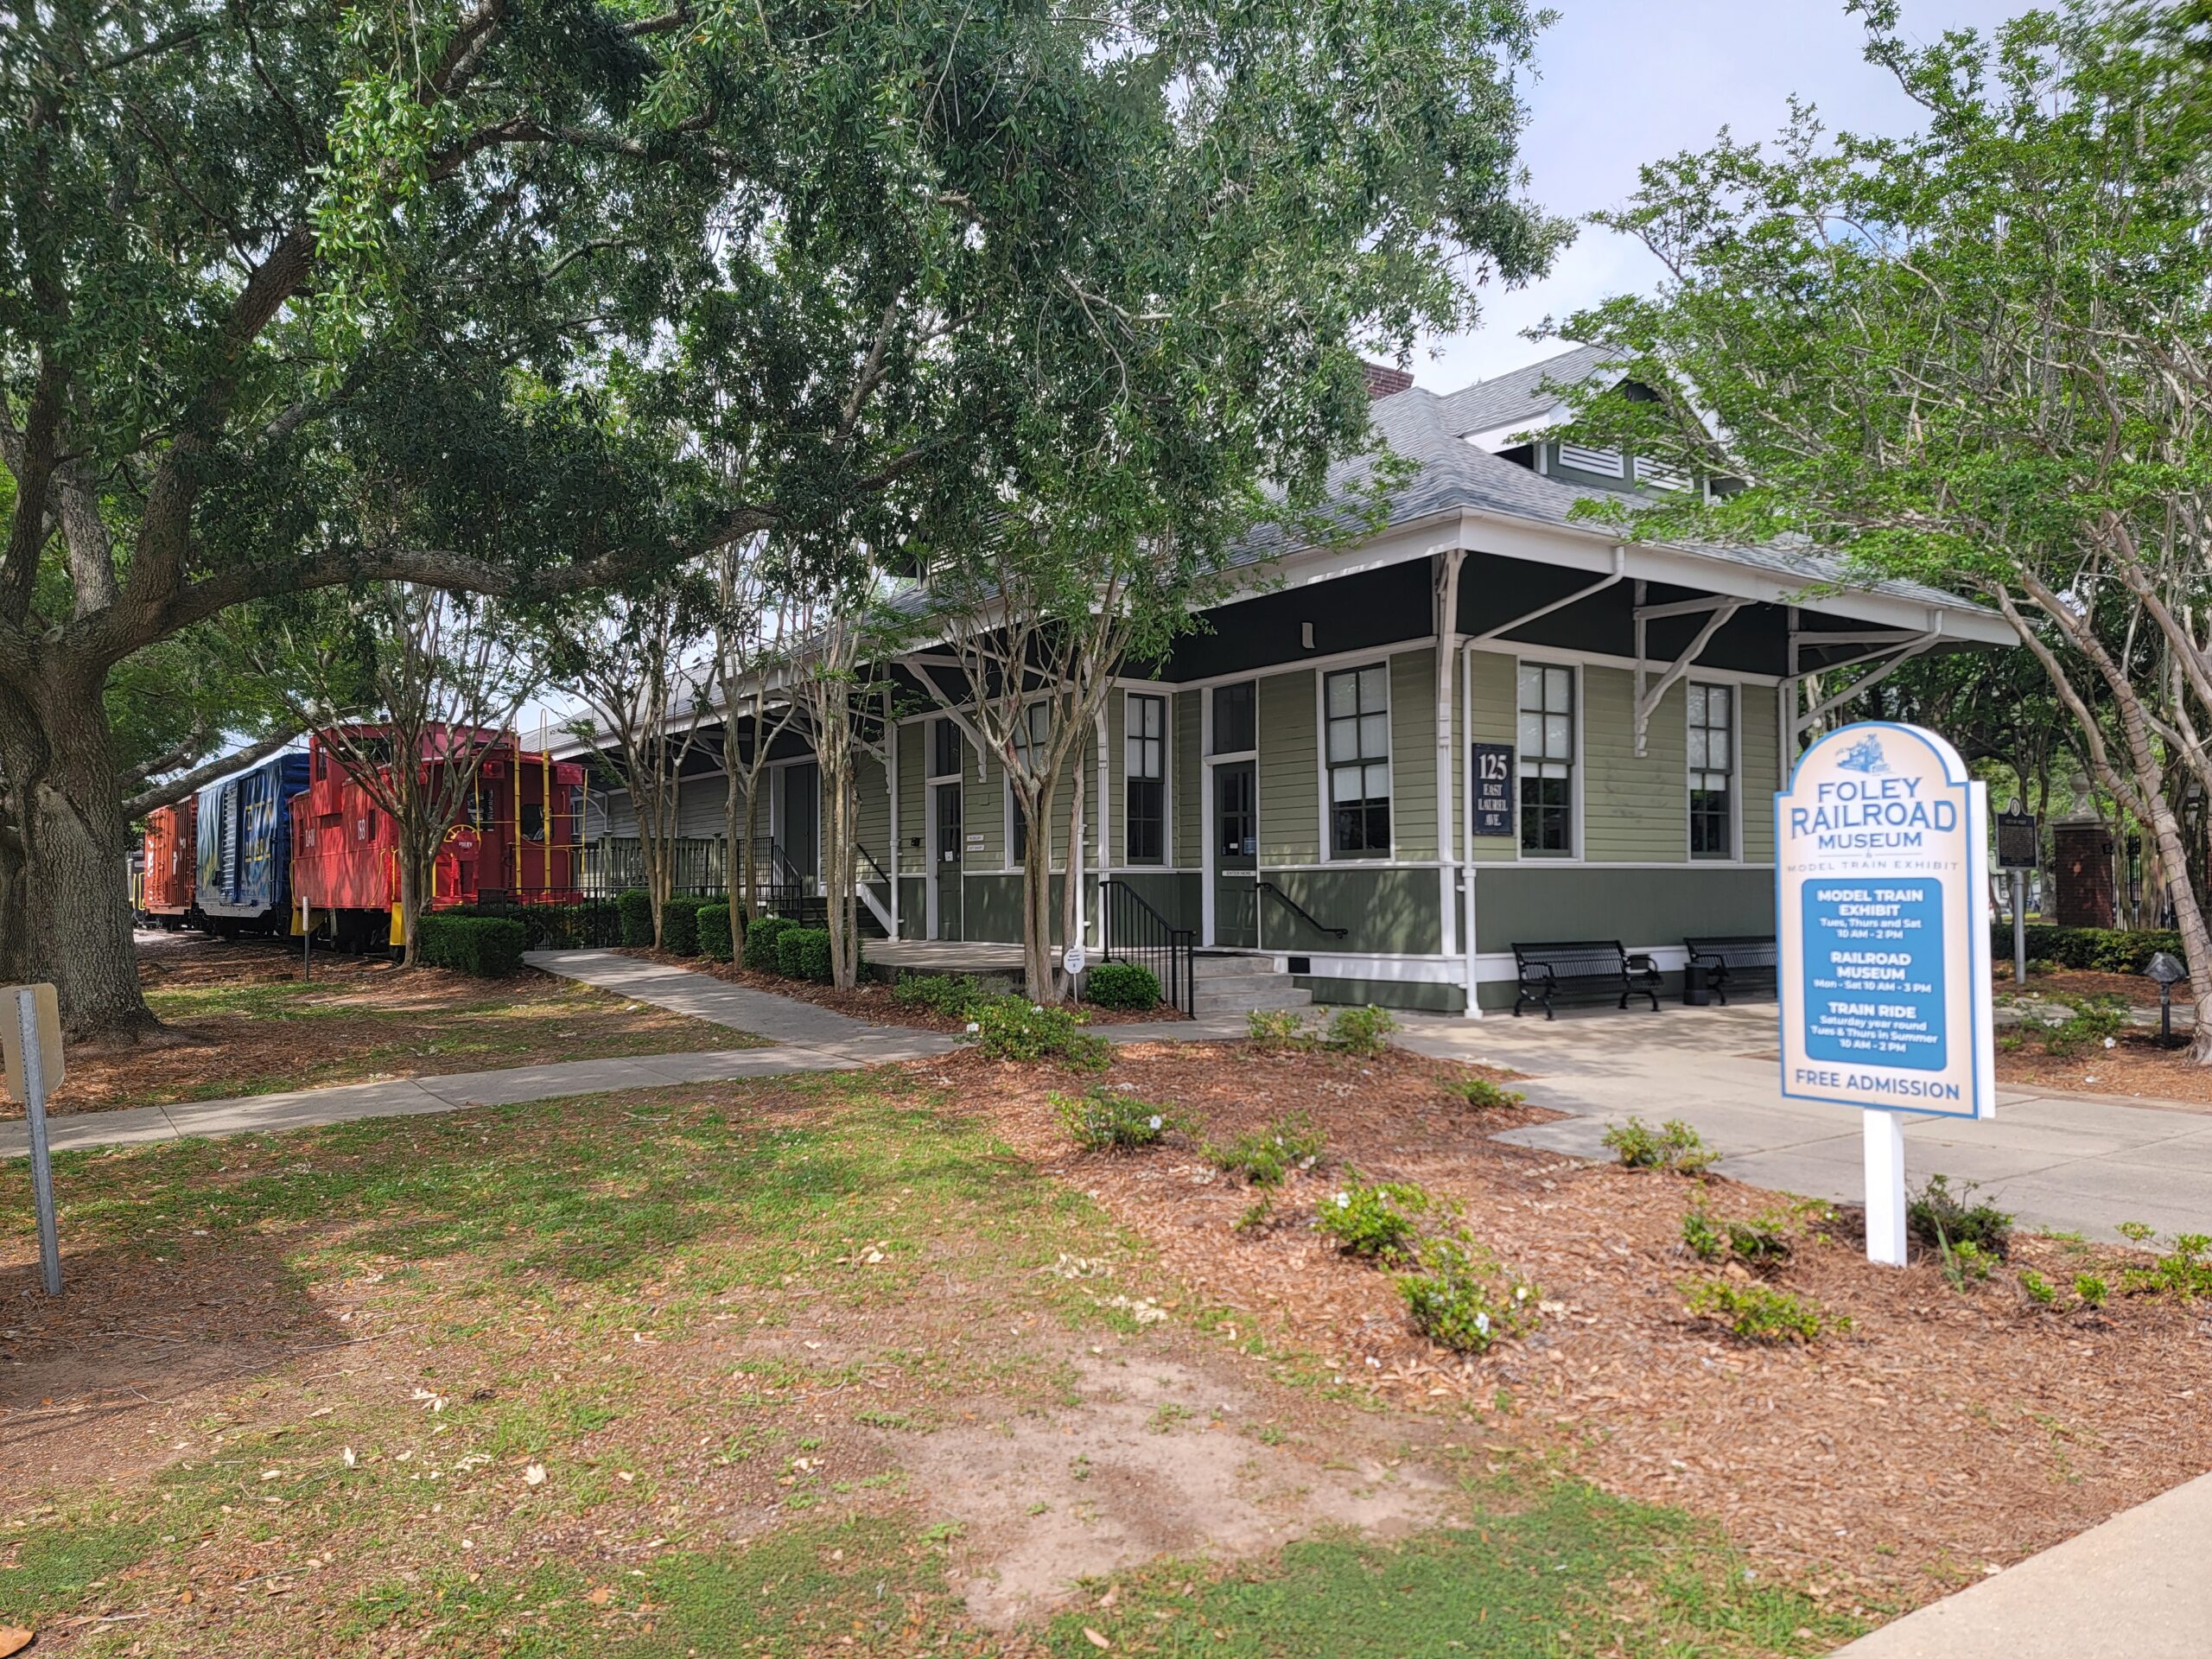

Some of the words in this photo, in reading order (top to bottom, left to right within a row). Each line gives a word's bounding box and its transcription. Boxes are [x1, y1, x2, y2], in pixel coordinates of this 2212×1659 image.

[1478, 753, 1507, 780] 125
[1483, 783, 1503, 796] EAST
[1817, 777, 1923, 803] FOLEY
[1790, 800, 1957, 839] RAILROAD
[1818, 831, 1923, 850] MUSEUM
[1787, 862, 1835, 873] MODEL
[1842, 861, 1887, 869] TRAIN
[1894, 861, 1959, 871] EXHIBIT
[1817, 889, 1872, 902] MODEL
[1874, 889, 1923, 902] TRAIN
[1839, 904, 1901, 916] EXHIBIT
[1820, 918, 1847, 928] Tues,
[1849, 918, 1878, 927] Thurs
[1879, 918, 1901, 928] and
[1903, 918, 1923, 929] Sat
[1837, 930, 1848, 938] 10
[1851, 930, 1868, 938] AM
[1876, 930, 1884, 939] 2
[1885, 930, 1904, 939] PM
[1830, 950, 1912, 966] RAILROAD
[1836, 966, 1905, 981] MUSEUM
[1814, 978, 1837, 989] Mon
[1844, 980, 1862, 990] Sat
[1863, 981, 1875, 990] 10
[1877, 982, 1896, 992] AM
[1904, 982, 1911, 993] 3
[1912, 983, 1932, 994] PM
[1827, 1001, 1875, 1016] TRAIN
[1878, 1004, 1916, 1020] RIDE
[1819, 1014, 1867, 1028] Saturday
[1867, 1020, 1892, 1030] year
[1892, 1020, 1927, 1032] round
[1810, 1025, 1835, 1036] Tues
[1846, 1027, 1877, 1039] Thurs
[1878, 1028, 1889, 1040] in
[1890, 1030, 1938, 1044] Summer
[1839, 1039, 1852, 1048] 10
[1853, 1039, 1872, 1050] AM
[1878, 1040, 1887, 1052] 2
[1888, 1042, 1907, 1052] PM
[1796, 1069, 1840, 1088] FREE
[1846, 1074, 1960, 1100] ADMISSION
